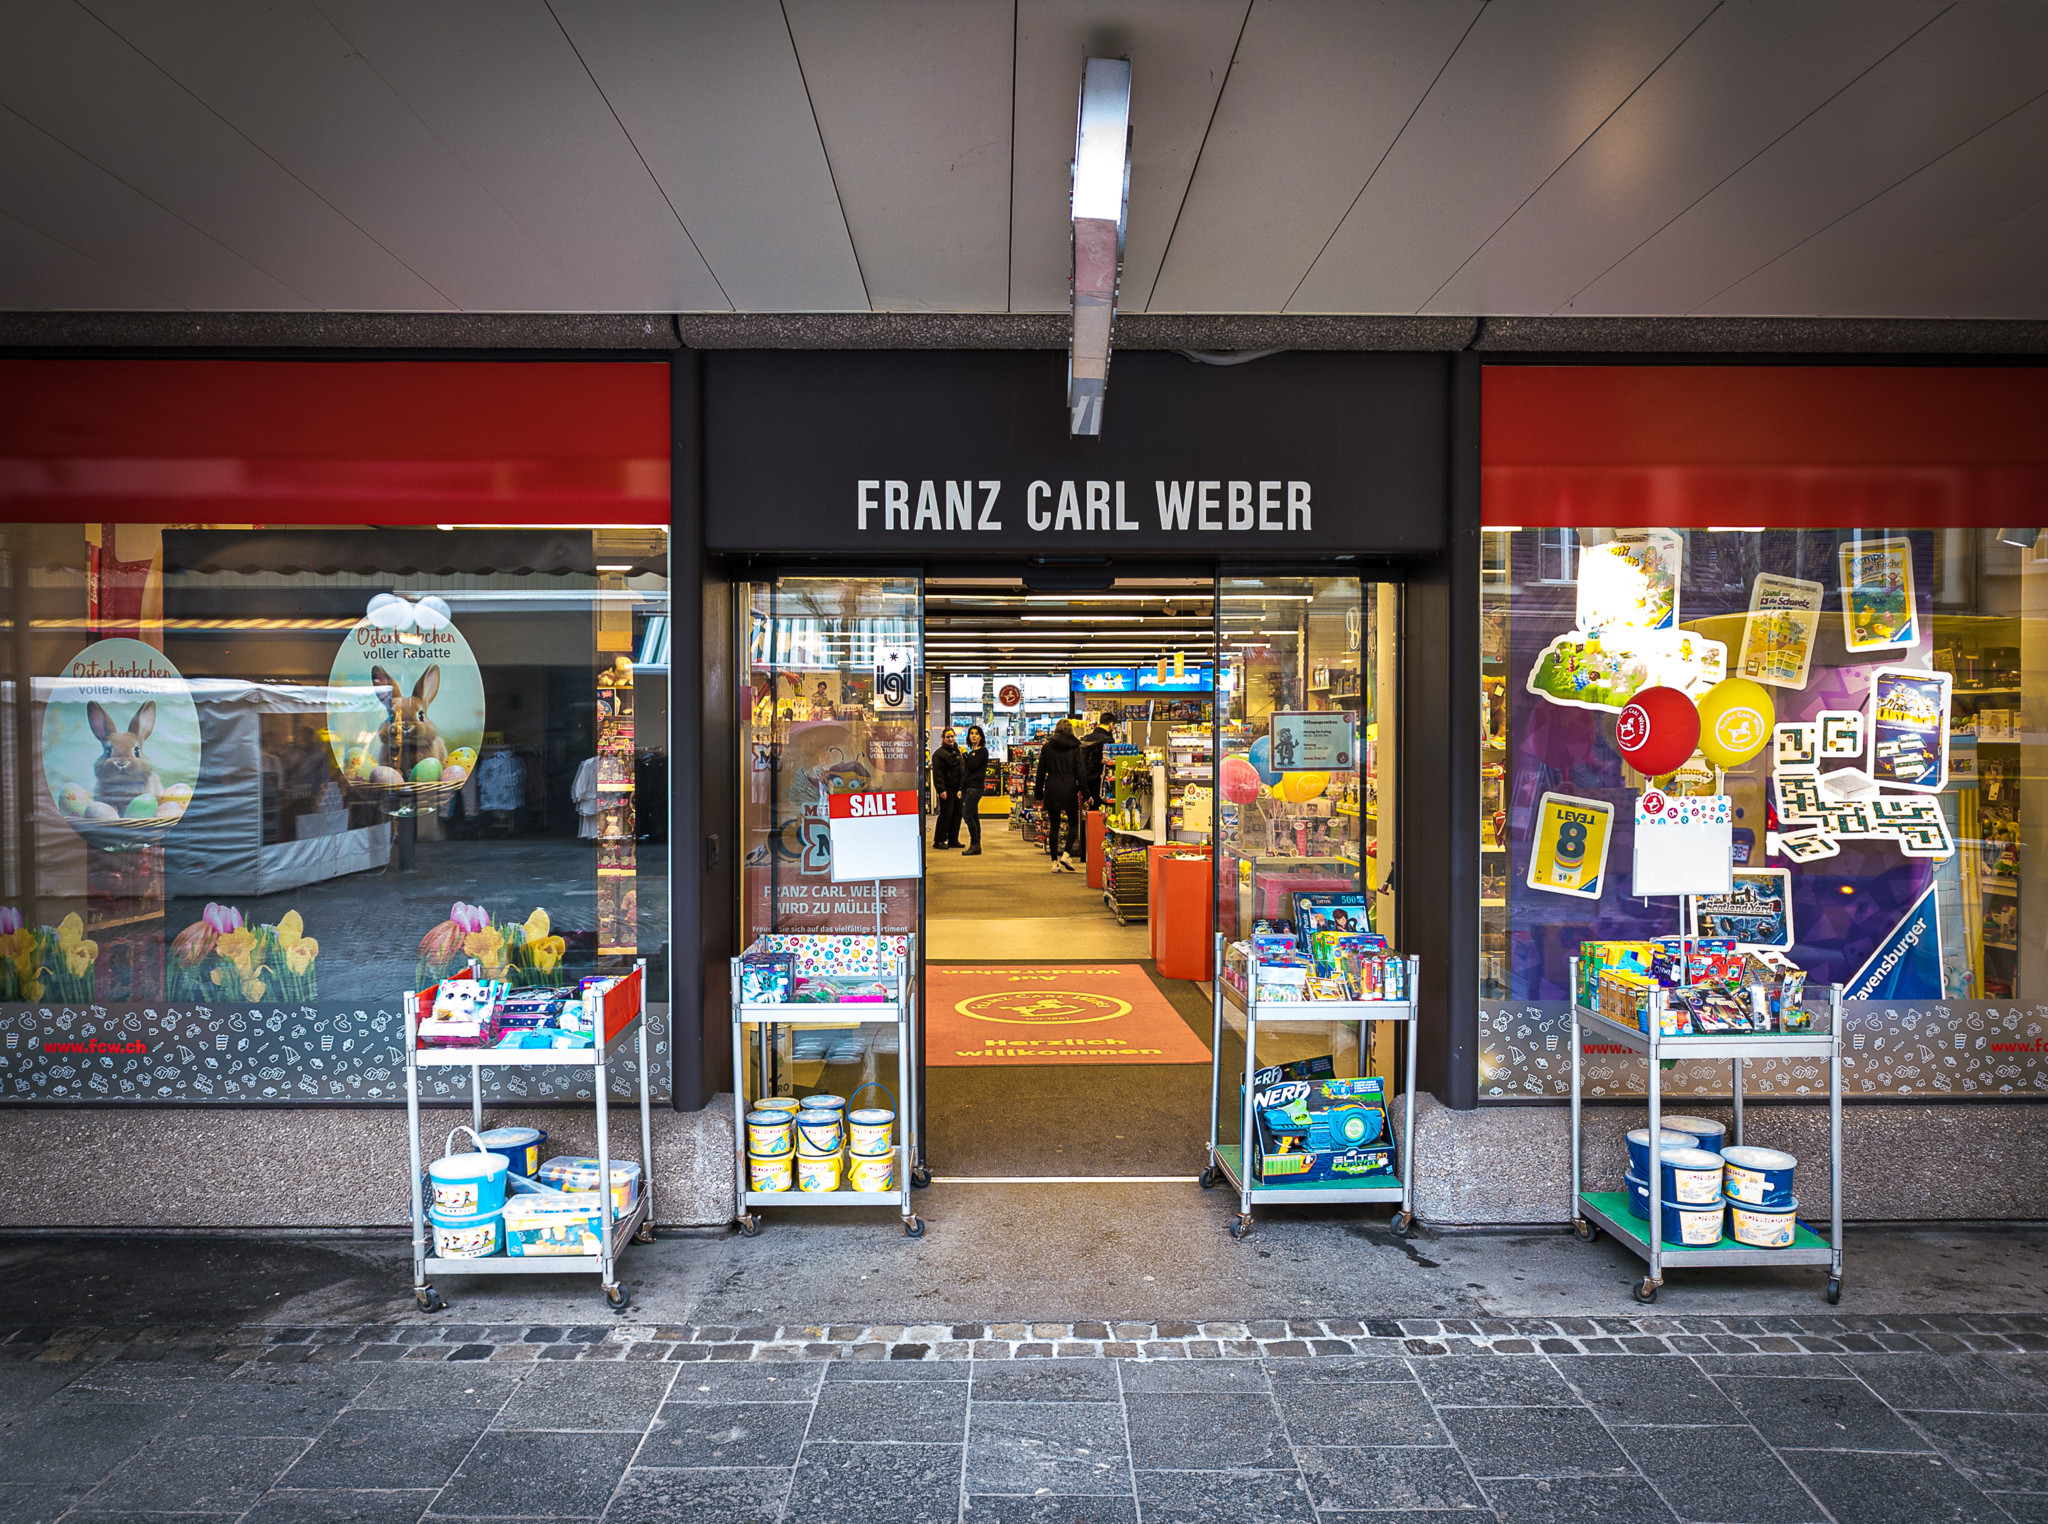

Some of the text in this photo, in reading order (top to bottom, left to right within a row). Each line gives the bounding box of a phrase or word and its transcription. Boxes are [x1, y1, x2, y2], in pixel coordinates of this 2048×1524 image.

[857, 479, 1312, 532] FRANZ CARL WEBER
[363, 647, 451, 660] voller Rabatte
[79, 681, 113, 695] voller
[850, 793, 897, 817] SALE
[1555, 821, 1588, 858] 8
[811, 886, 847, 898] CARL
[812, 902, 830, 914] ZU
[834, 899, 888, 914] MÜLLER
[1341, 895, 1357, 904] 500
[1706, 901, 1774, 915] Scotland Yard
[752, 925, 908, 934] Freue Sie sich auf das vielfältige Srtiment
[44, 1038, 147, 1054] www.fcw.ch
[984, 1038, 1128, 1047] Herzlich
[955, 1048, 1163, 1057] willkommen
[1253, 1080, 1311, 1109] NERF
[1333, 1153, 1377, 1164] ELITE
